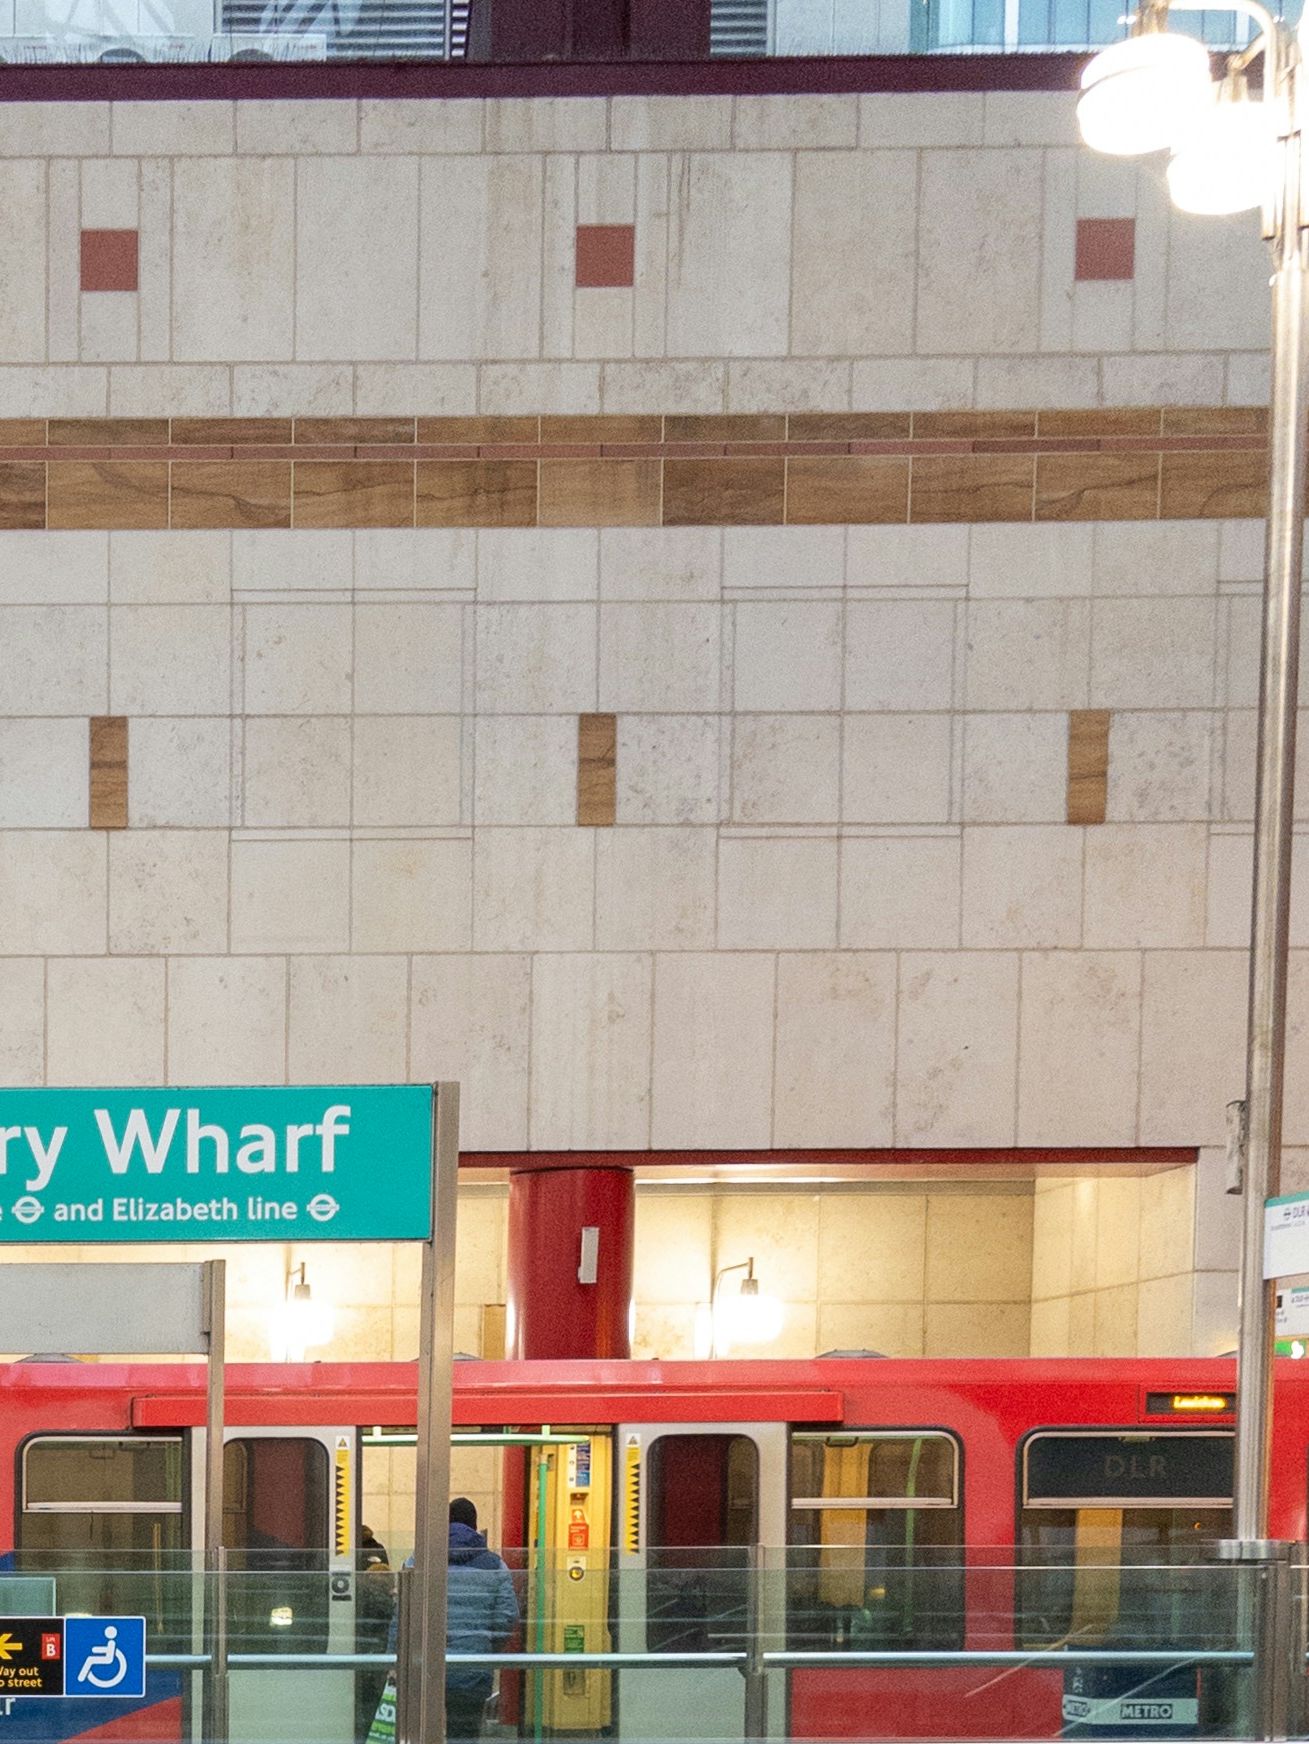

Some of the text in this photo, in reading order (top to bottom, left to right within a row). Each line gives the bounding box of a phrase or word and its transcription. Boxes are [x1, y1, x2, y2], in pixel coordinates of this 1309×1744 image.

[93, 1104, 352, 1174] Wharf
[53, 1198, 103, 1222] and
[112, 1197, 238, 1222] Elizabeth
[247, 1195, 298, 1220] line
[1104, 1454, 1168, 1479] DLR
[46, 1644, 56, 1657] B
[18, 1666, 39, 1677] out
[6, 1678, 43, 1688] street
[1121, 1705, 1172, 1718] METRO
